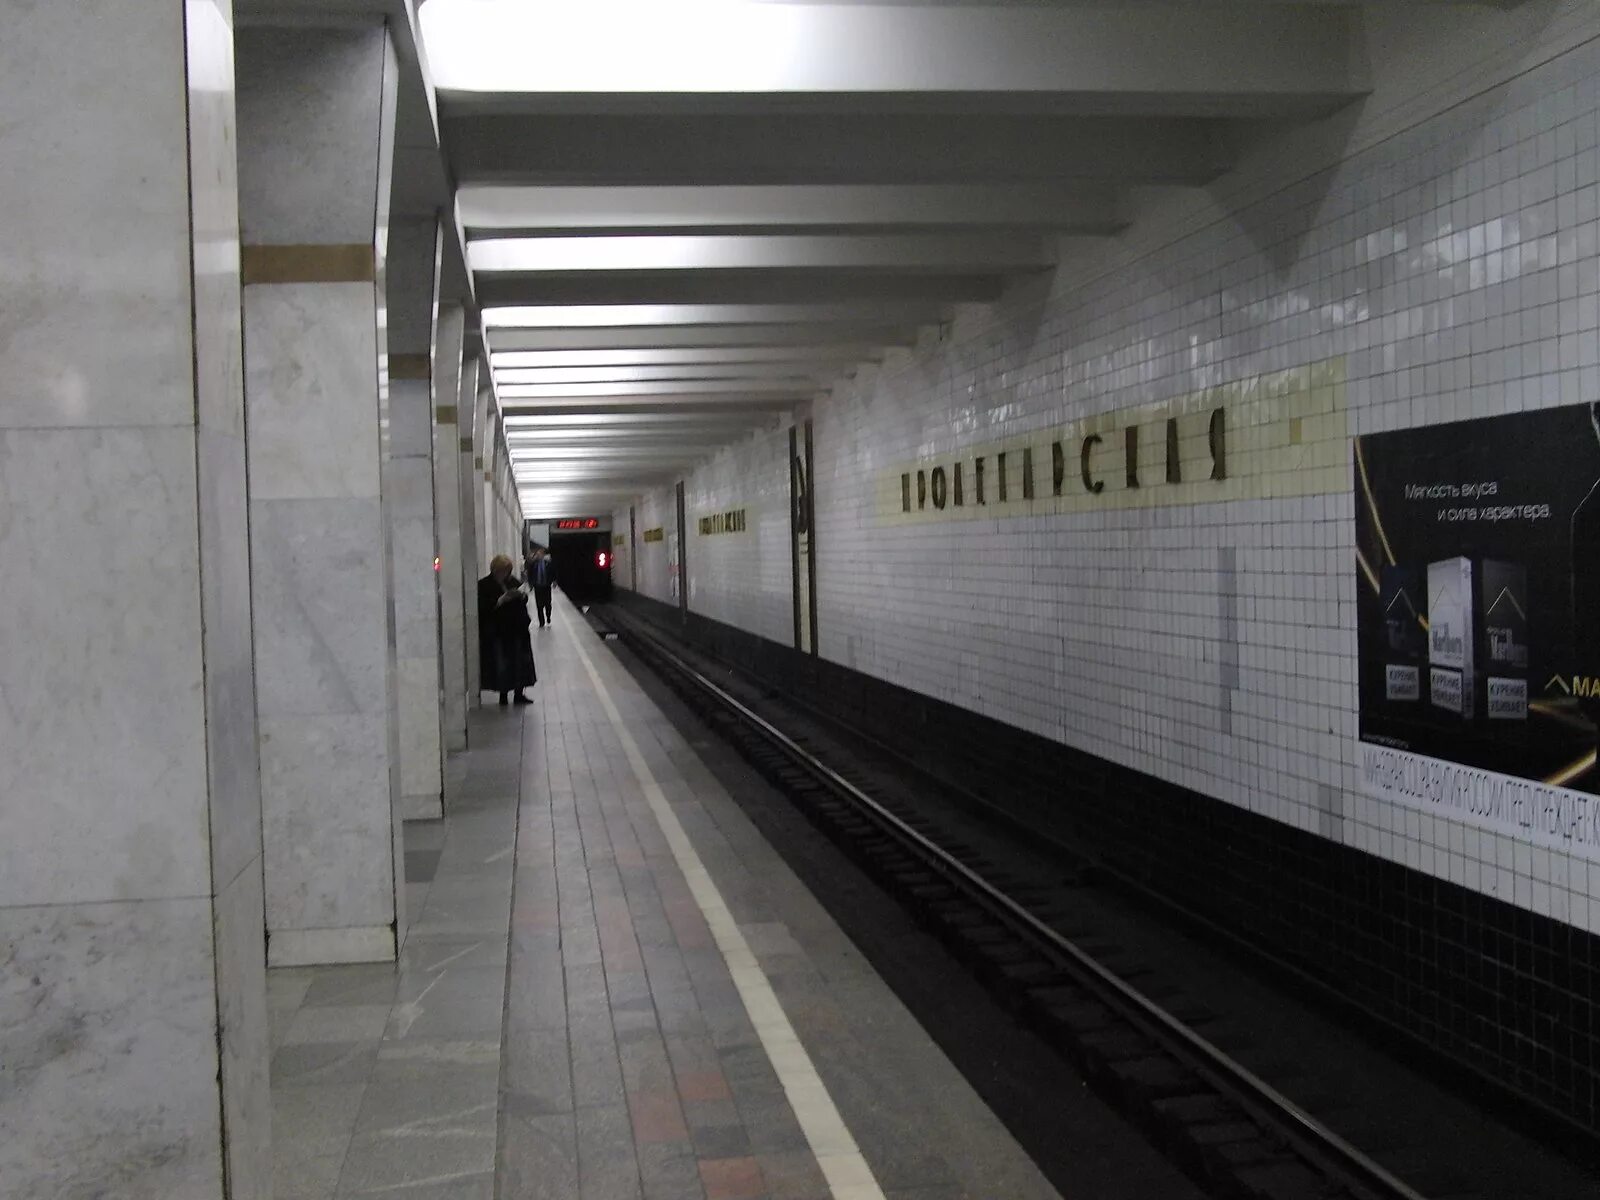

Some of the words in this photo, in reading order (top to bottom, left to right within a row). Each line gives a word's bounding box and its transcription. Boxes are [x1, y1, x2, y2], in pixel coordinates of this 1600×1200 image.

[1404, 483, 1460, 499] Мягкость
[1462, 481, 1498, 500] вкуса
[1437, 509, 1446, 521] и
[1447, 507, 1477, 521] сила
